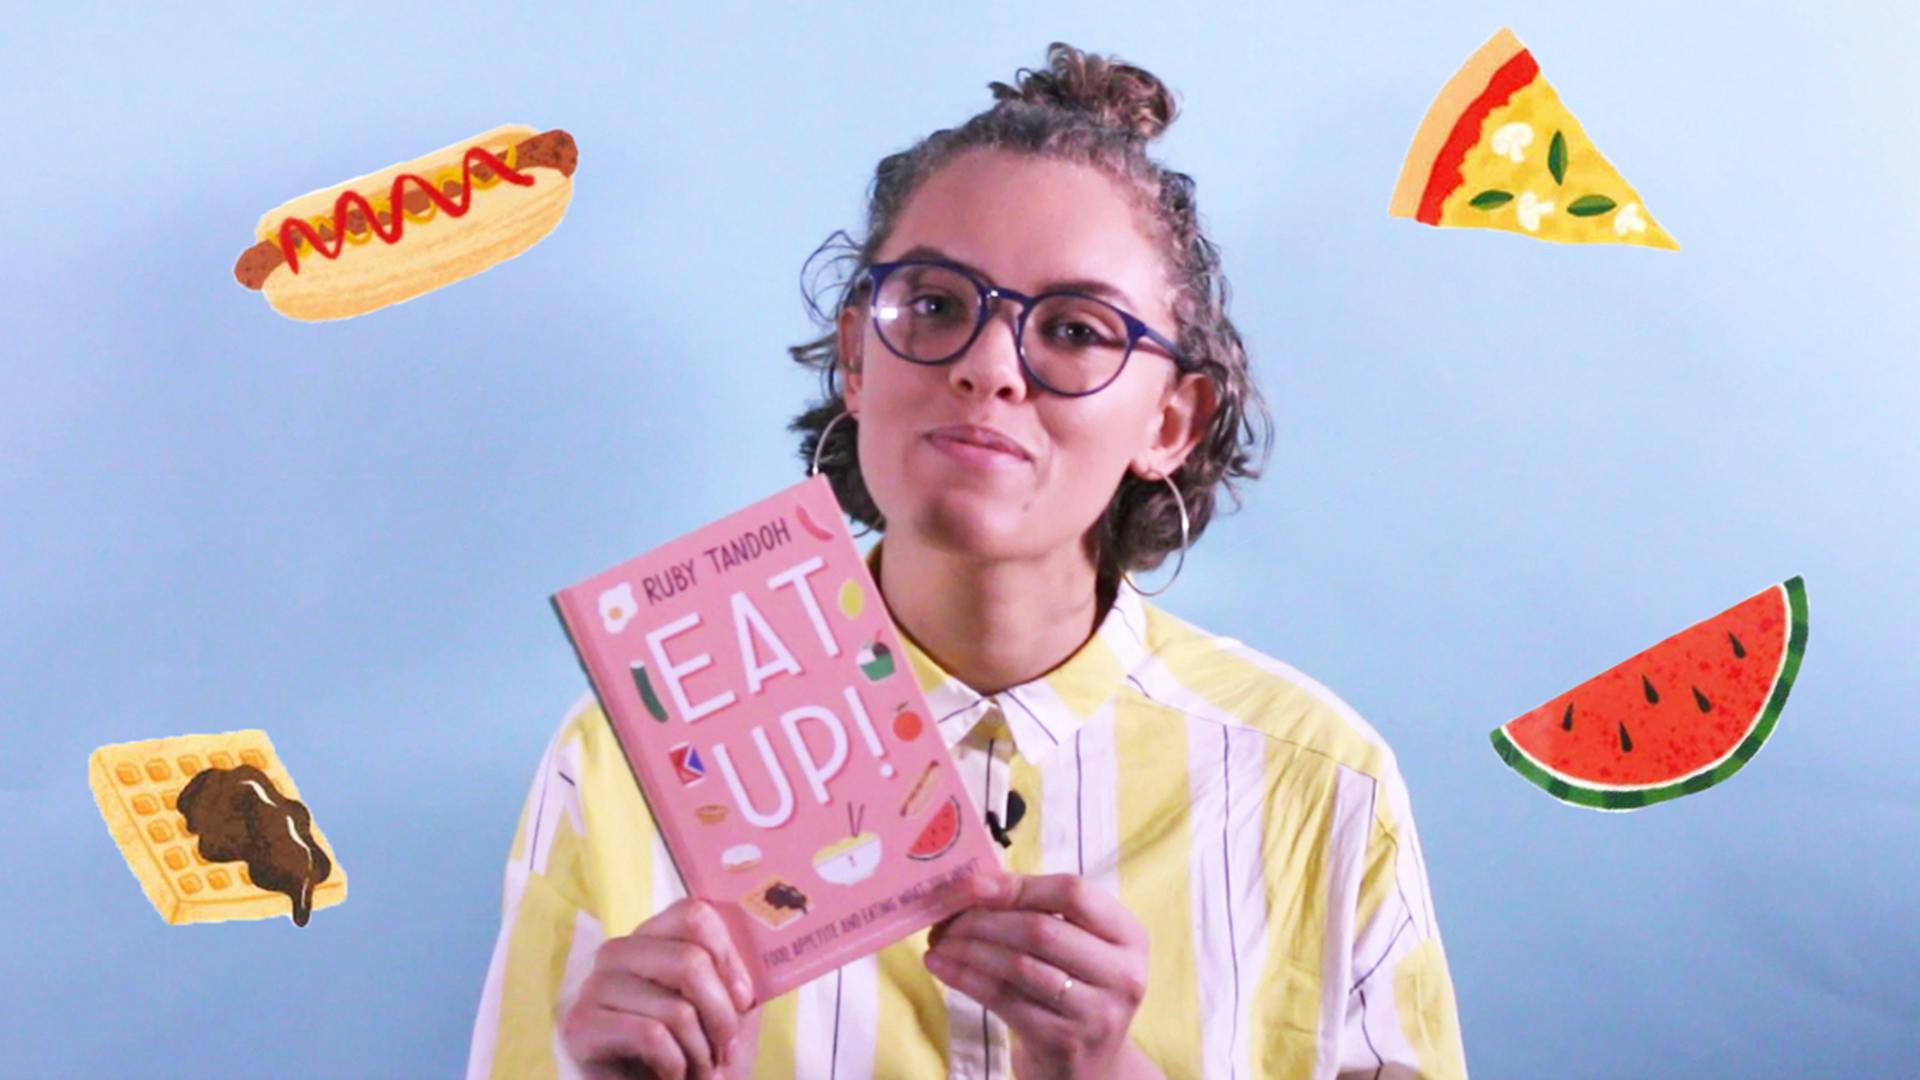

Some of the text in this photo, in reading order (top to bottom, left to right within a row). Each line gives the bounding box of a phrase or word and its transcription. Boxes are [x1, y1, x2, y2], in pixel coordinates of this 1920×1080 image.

[642, 518, 792, 605] RUBY TANDOH
[645, 555, 841, 723] EAT
[712, 686, 893, 829] UP!
[840, 910, 862, 933] AND
